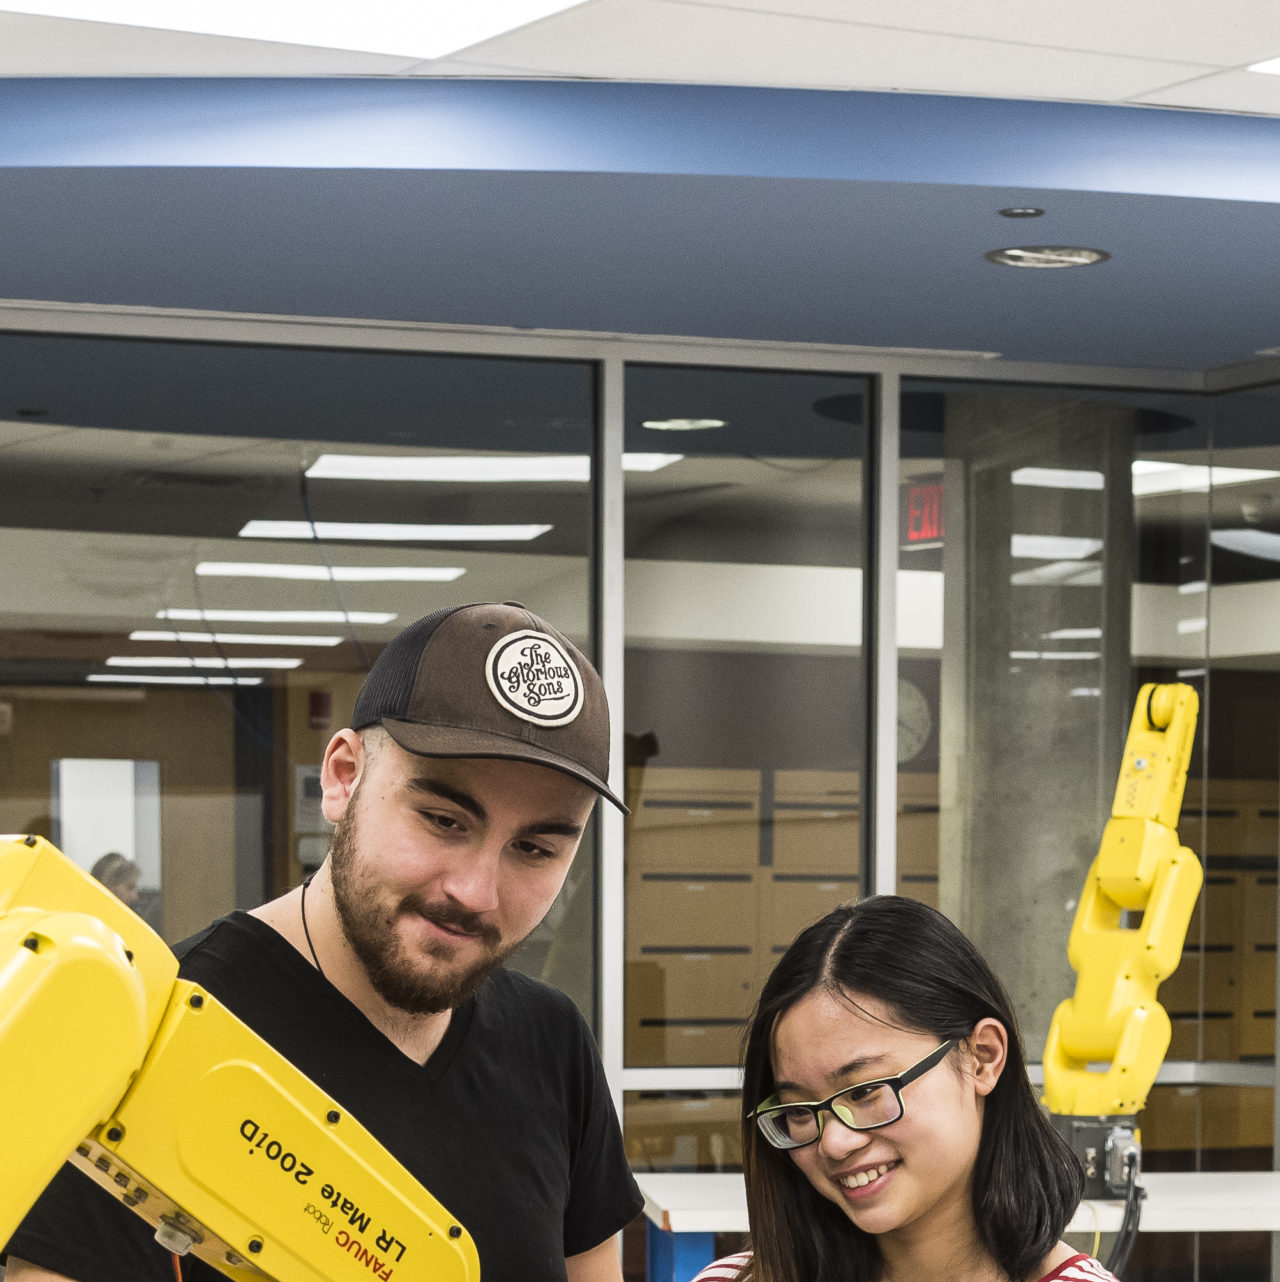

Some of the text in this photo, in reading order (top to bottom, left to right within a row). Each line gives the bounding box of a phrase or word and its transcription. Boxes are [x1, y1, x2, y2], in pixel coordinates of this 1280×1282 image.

[521, 644, 551, 669] The
[500, 662, 569, 693] Glorious
[523, 680, 569, 706] Sons
[240, 1119, 407, 1263] LR Mate 200iD
[304, 1202, 394, 1282] FANUC Robot
